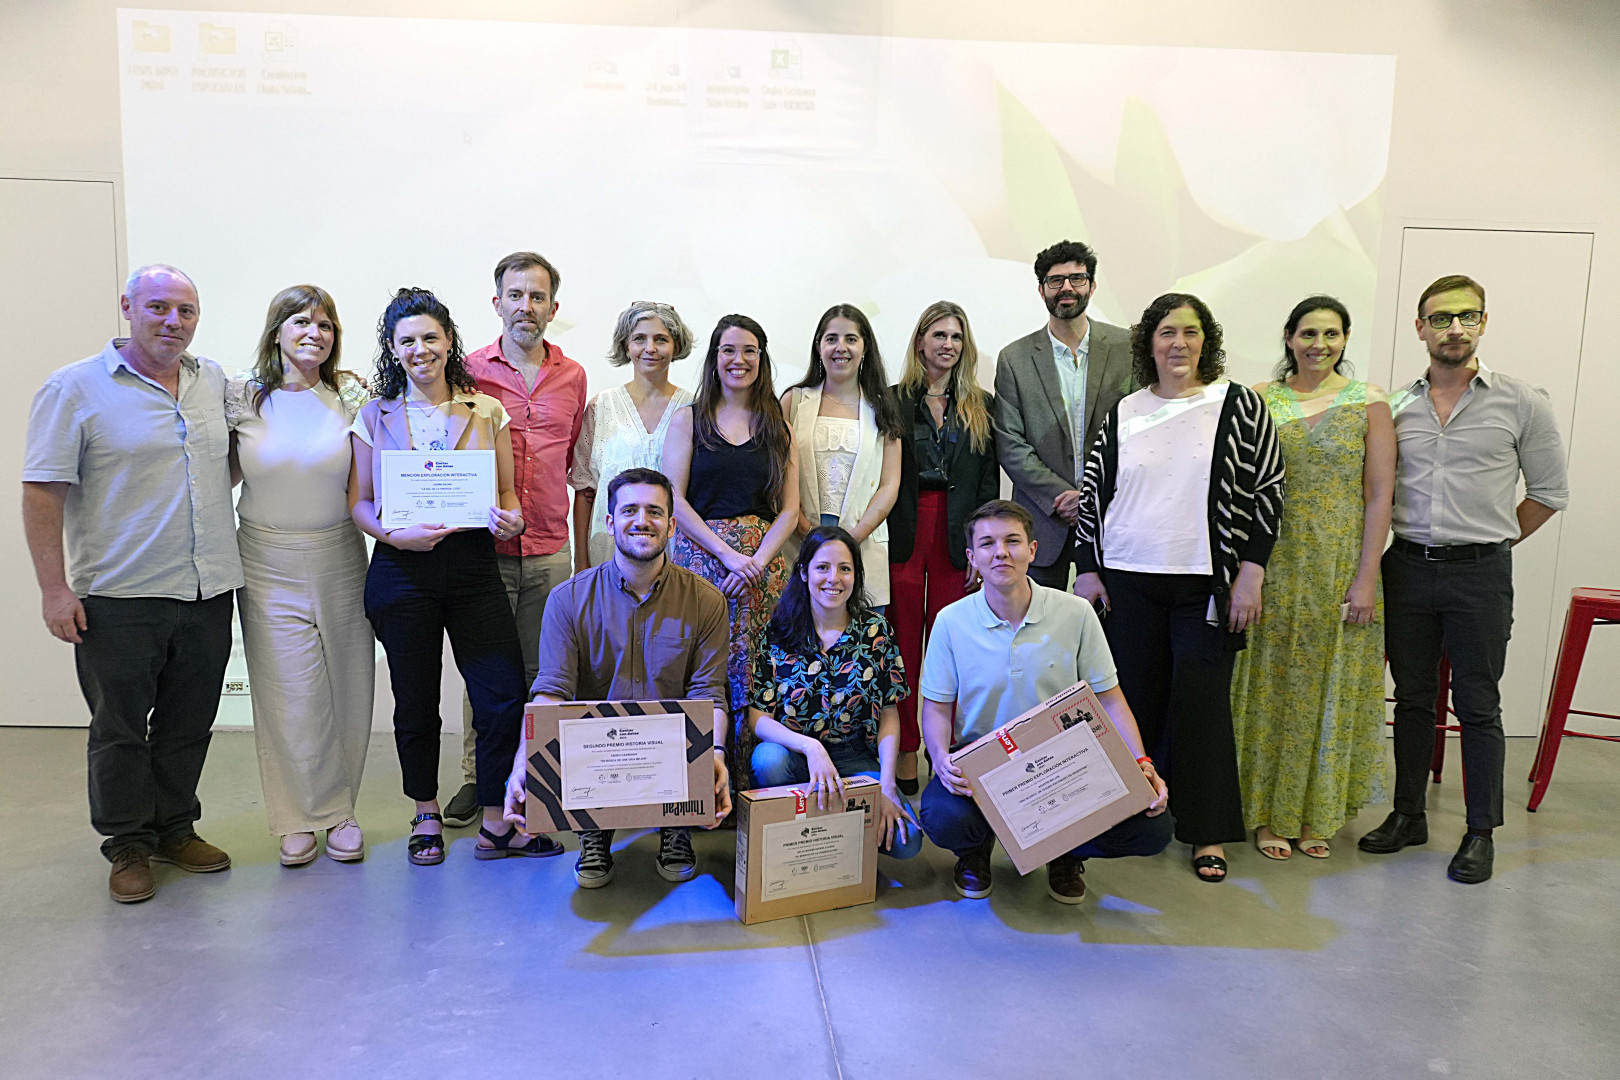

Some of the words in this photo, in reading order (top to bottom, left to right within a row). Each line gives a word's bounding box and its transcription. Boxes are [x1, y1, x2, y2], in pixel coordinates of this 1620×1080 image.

[1002, 785, 1019, 796] PRIMER
[1018, 777, 1034, 788] PREMIO
[1033, 762, 1062, 780] EXPLORACIÓN
[1061, 747, 1089, 766] INTERACTIVA
[663, 799, 706, 817] ThinkPad
